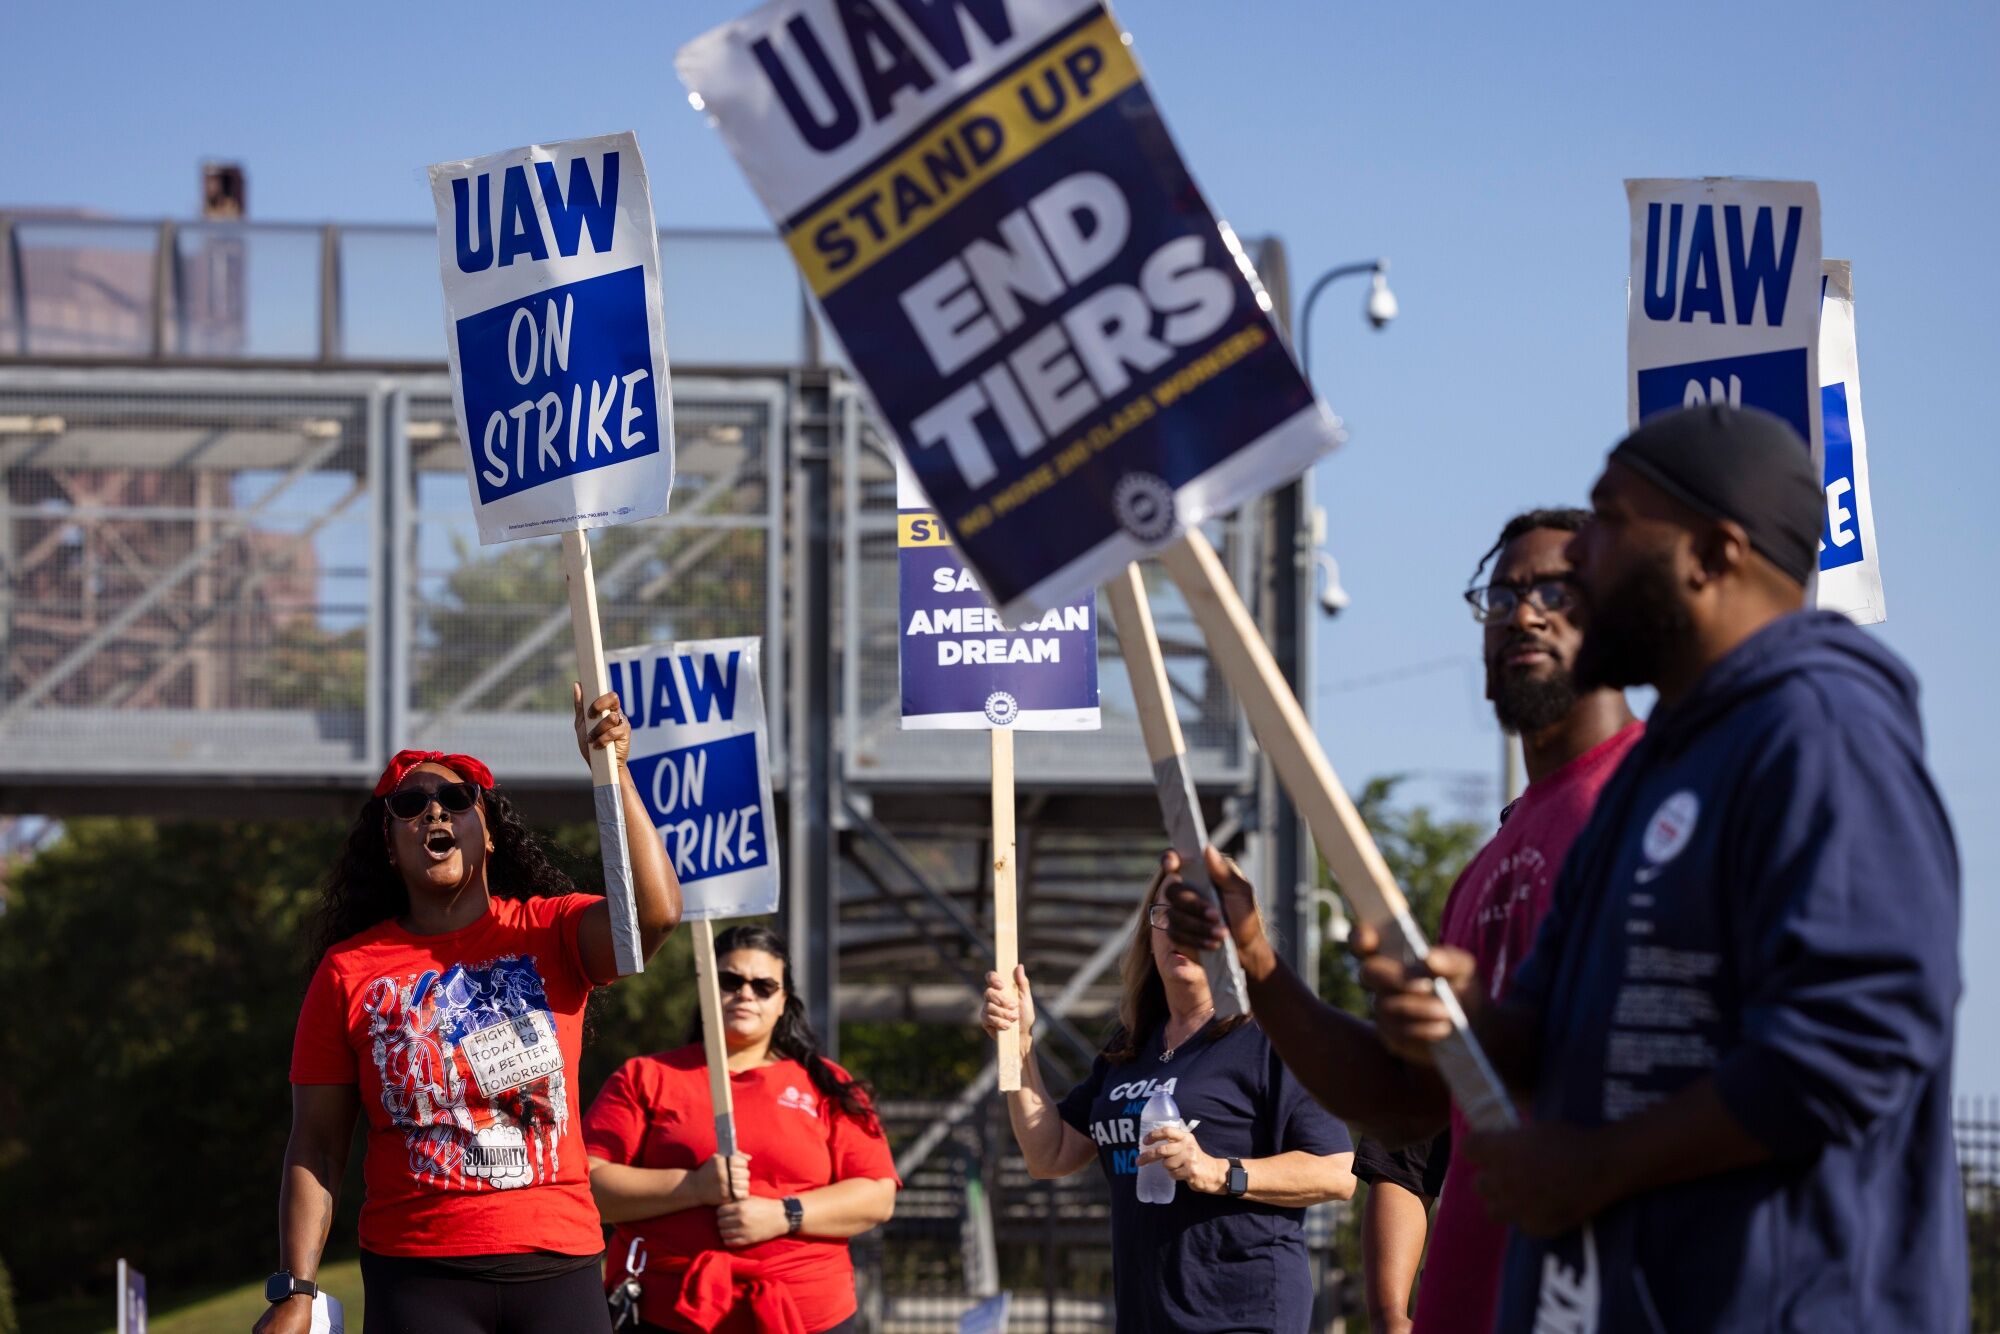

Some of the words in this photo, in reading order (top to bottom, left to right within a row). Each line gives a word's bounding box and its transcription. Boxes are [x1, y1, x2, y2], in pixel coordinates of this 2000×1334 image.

[813, 115, 1007, 272] STAND
[1016, 44, 1107, 125] UP
[452, 152, 619, 273] UAW
[899, 171, 1130, 377] END
[1644, 202, 1803, 327] UAW
[508, 293, 574, 385] ON
[910, 235, 1236, 490] TIERS
[483, 369, 649, 487] STRIKE
[932, 567, 982, 593] SA
[906, 606, 1089, 635] AMERAN
[938, 638, 1060, 666] DREAM
[608, 651, 741, 729] UAW
[652, 749, 708, 815] ON
[656, 804, 760, 878] TRIKE
[472, 1038, 517, 1062] TODAY
[520, 1031, 547, 1047] FOR
[474, 1017, 536, 1045] FIGHTING
[482, 1057, 560, 1093] TOMORROW
[488, 1063, 497, 1075] A
[500, 1046, 550, 1071] BETTER
[1109, 1077, 1178, 1101] COLA
[1122, 1100, 1147, 1116] AN
[464, 1147, 526, 1167] SOLIDARITY
[1113, 1149, 1138, 1175] NO
